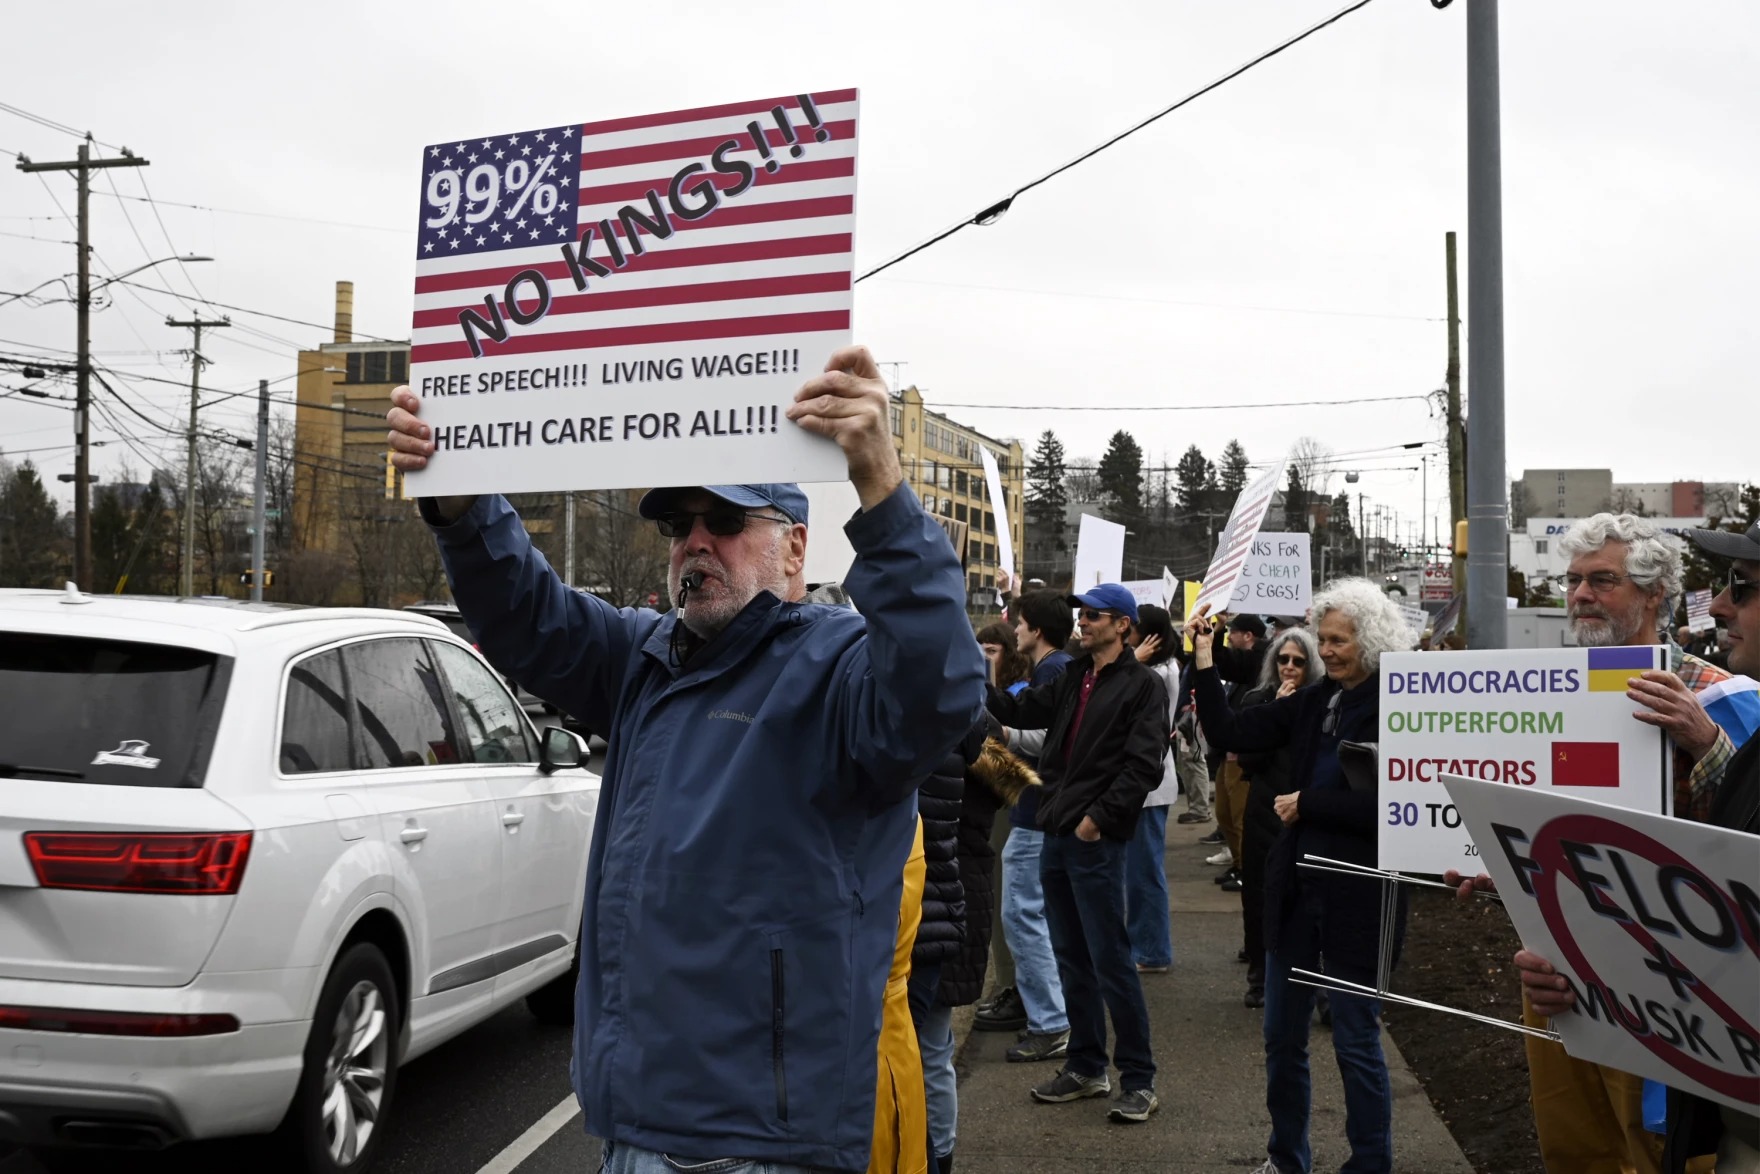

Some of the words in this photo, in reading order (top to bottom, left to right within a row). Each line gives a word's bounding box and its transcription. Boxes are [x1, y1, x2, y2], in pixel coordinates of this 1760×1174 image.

[426, 154, 558, 229] 99%
[457, 269, 552, 359] NO
[560, 94, 831, 292] KINGS!!!
[421, 373, 472, 398] FREE
[477, 363, 588, 394] SPEECH!!!
[602, 357, 684, 385] LIVING
[692, 348, 800, 377] WAGE!!!
[434, 420, 532, 451] HEALTH
[541, 416, 613, 445] CARE
[623, 411, 681, 440] FOR
[690, 405, 779, 437] ALL!!!
[1278, 542, 1300, 557] FOR
[1259, 563, 1300, 579] CHEAP
[1256, 583, 1299, 600] EGGS!
[1388, 668, 1580, 694] DEMOCRACIES
[1387, 711, 1564, 734] OUTPERFORM
[1388, 758, 1537, 786] DICTATORS
[1387, 801, 1419, 827] 30
[1425, 803, 1462, 828] TO
[1556, 972, 1726, 1063] MUSK
